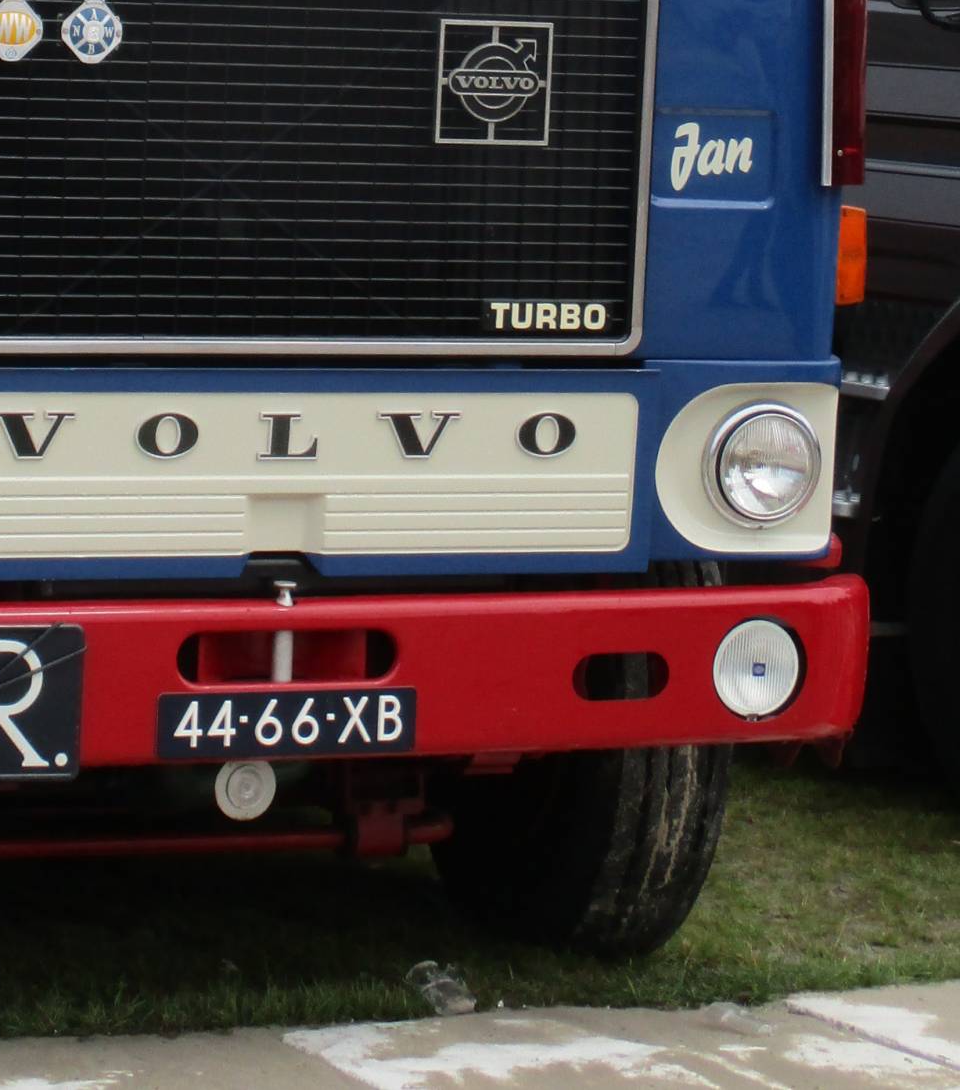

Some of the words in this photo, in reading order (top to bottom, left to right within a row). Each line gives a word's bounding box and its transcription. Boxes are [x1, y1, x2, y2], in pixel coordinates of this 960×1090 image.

[455, 75, 535, 91] VOLVO
[670, 122, 754, 191] Jan
[490, 302, 607, 330] TURBO
[173, 694, 403, 748] 44-66-XB
